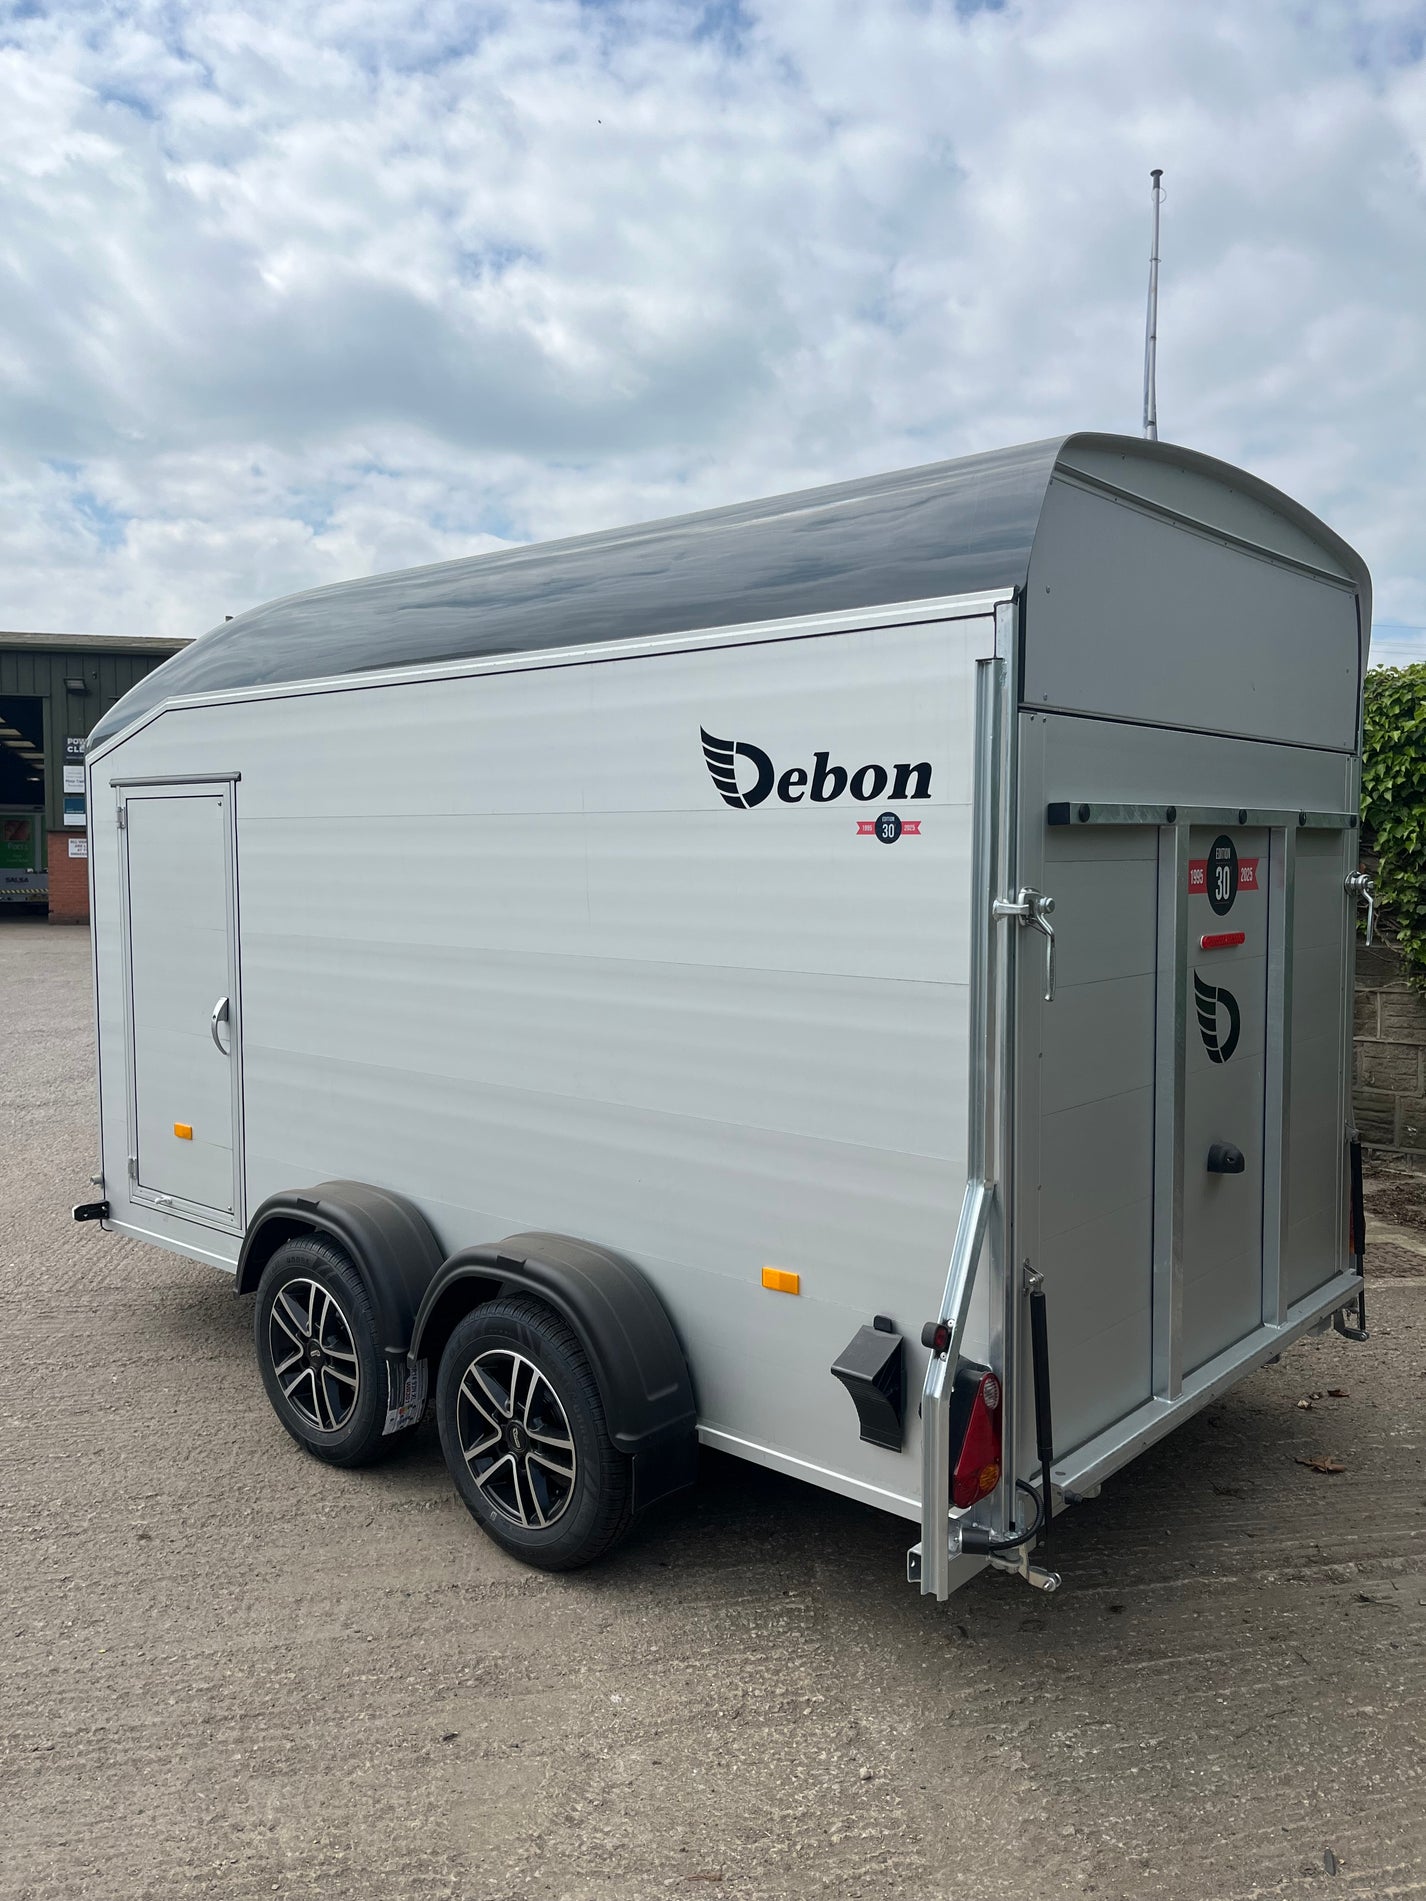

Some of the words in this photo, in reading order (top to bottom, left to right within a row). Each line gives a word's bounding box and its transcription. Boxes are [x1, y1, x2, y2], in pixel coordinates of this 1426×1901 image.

[700, 724, 932, 809] Debon
[882, 823, 895, 838] 30
[1215, 847, 1231, 860] EDITION
[1190, 869, 1204, 885] 1995
[1215, 865, 1230, 900] 30
[1240, 867, 1253, 882] 2025
